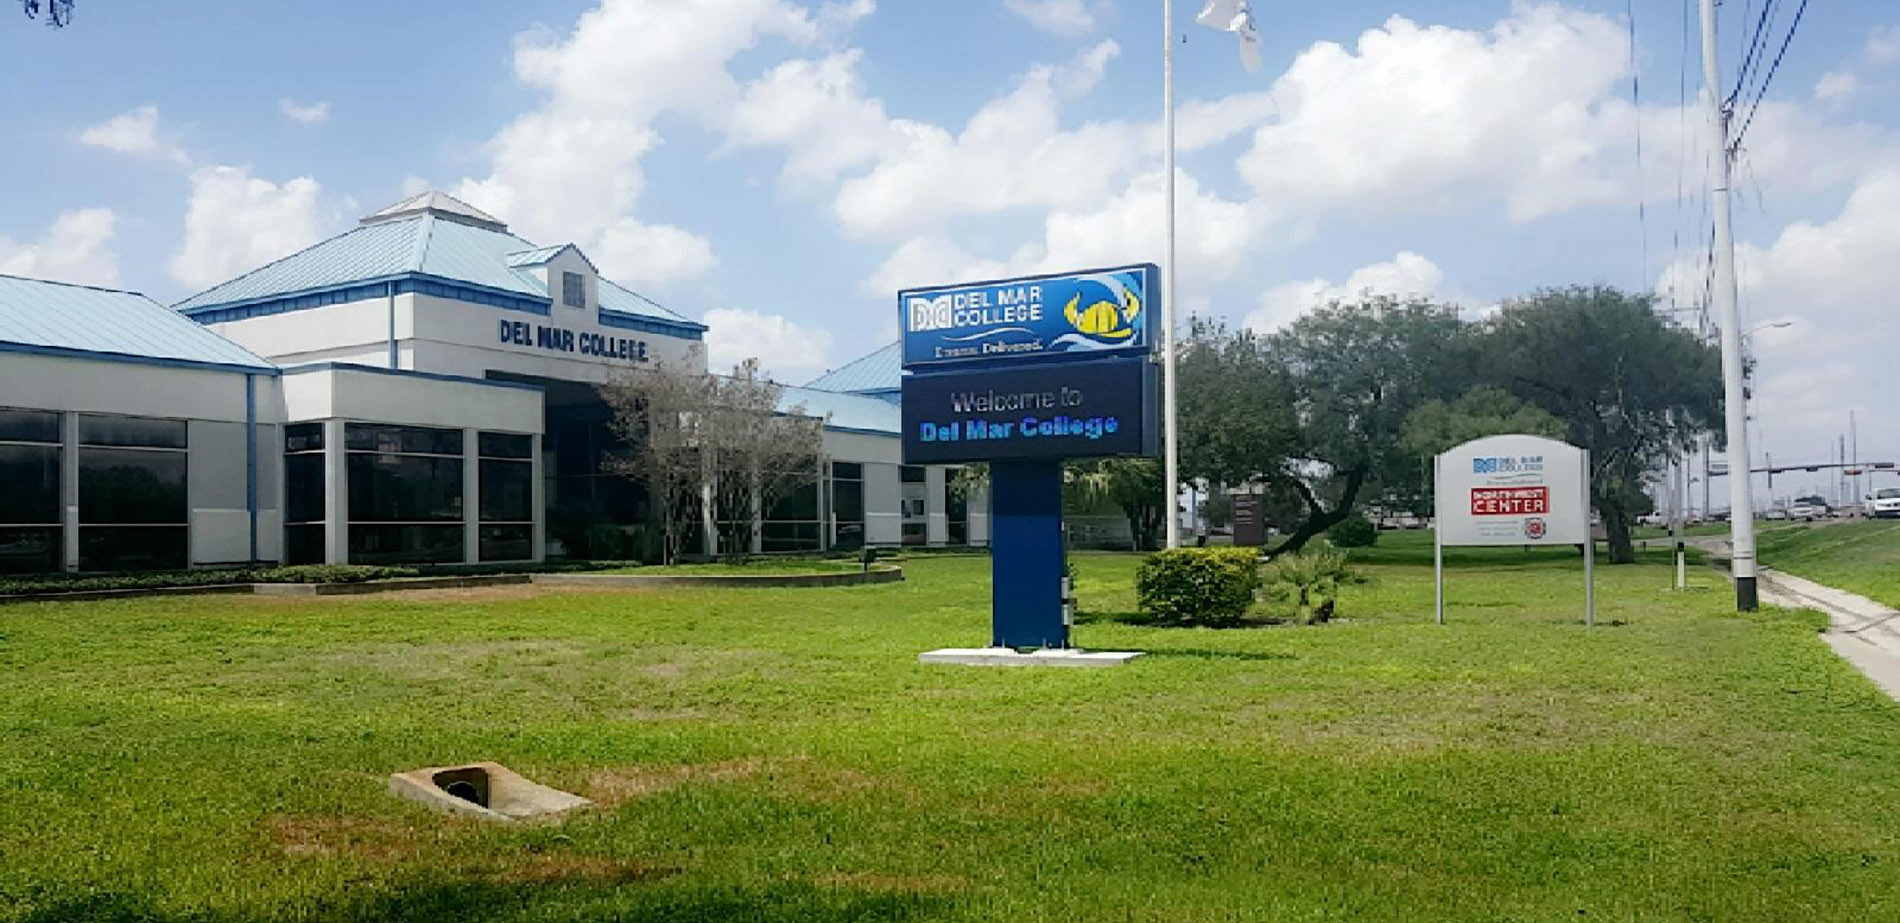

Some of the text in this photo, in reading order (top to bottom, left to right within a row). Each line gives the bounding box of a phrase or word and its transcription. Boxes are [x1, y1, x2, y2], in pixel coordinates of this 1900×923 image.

[954, 286, 1042, 310] DEL MAR
[954, 303, 1043, 326] COLLEGE
[500, 319, 649, 363] DEL MAR COLLEGE
[950, 386, 1082, 414] Welcome to
[920, 414, 1119, 442] Del Mar College
[1473, 499, 1544, 513] CENTER
